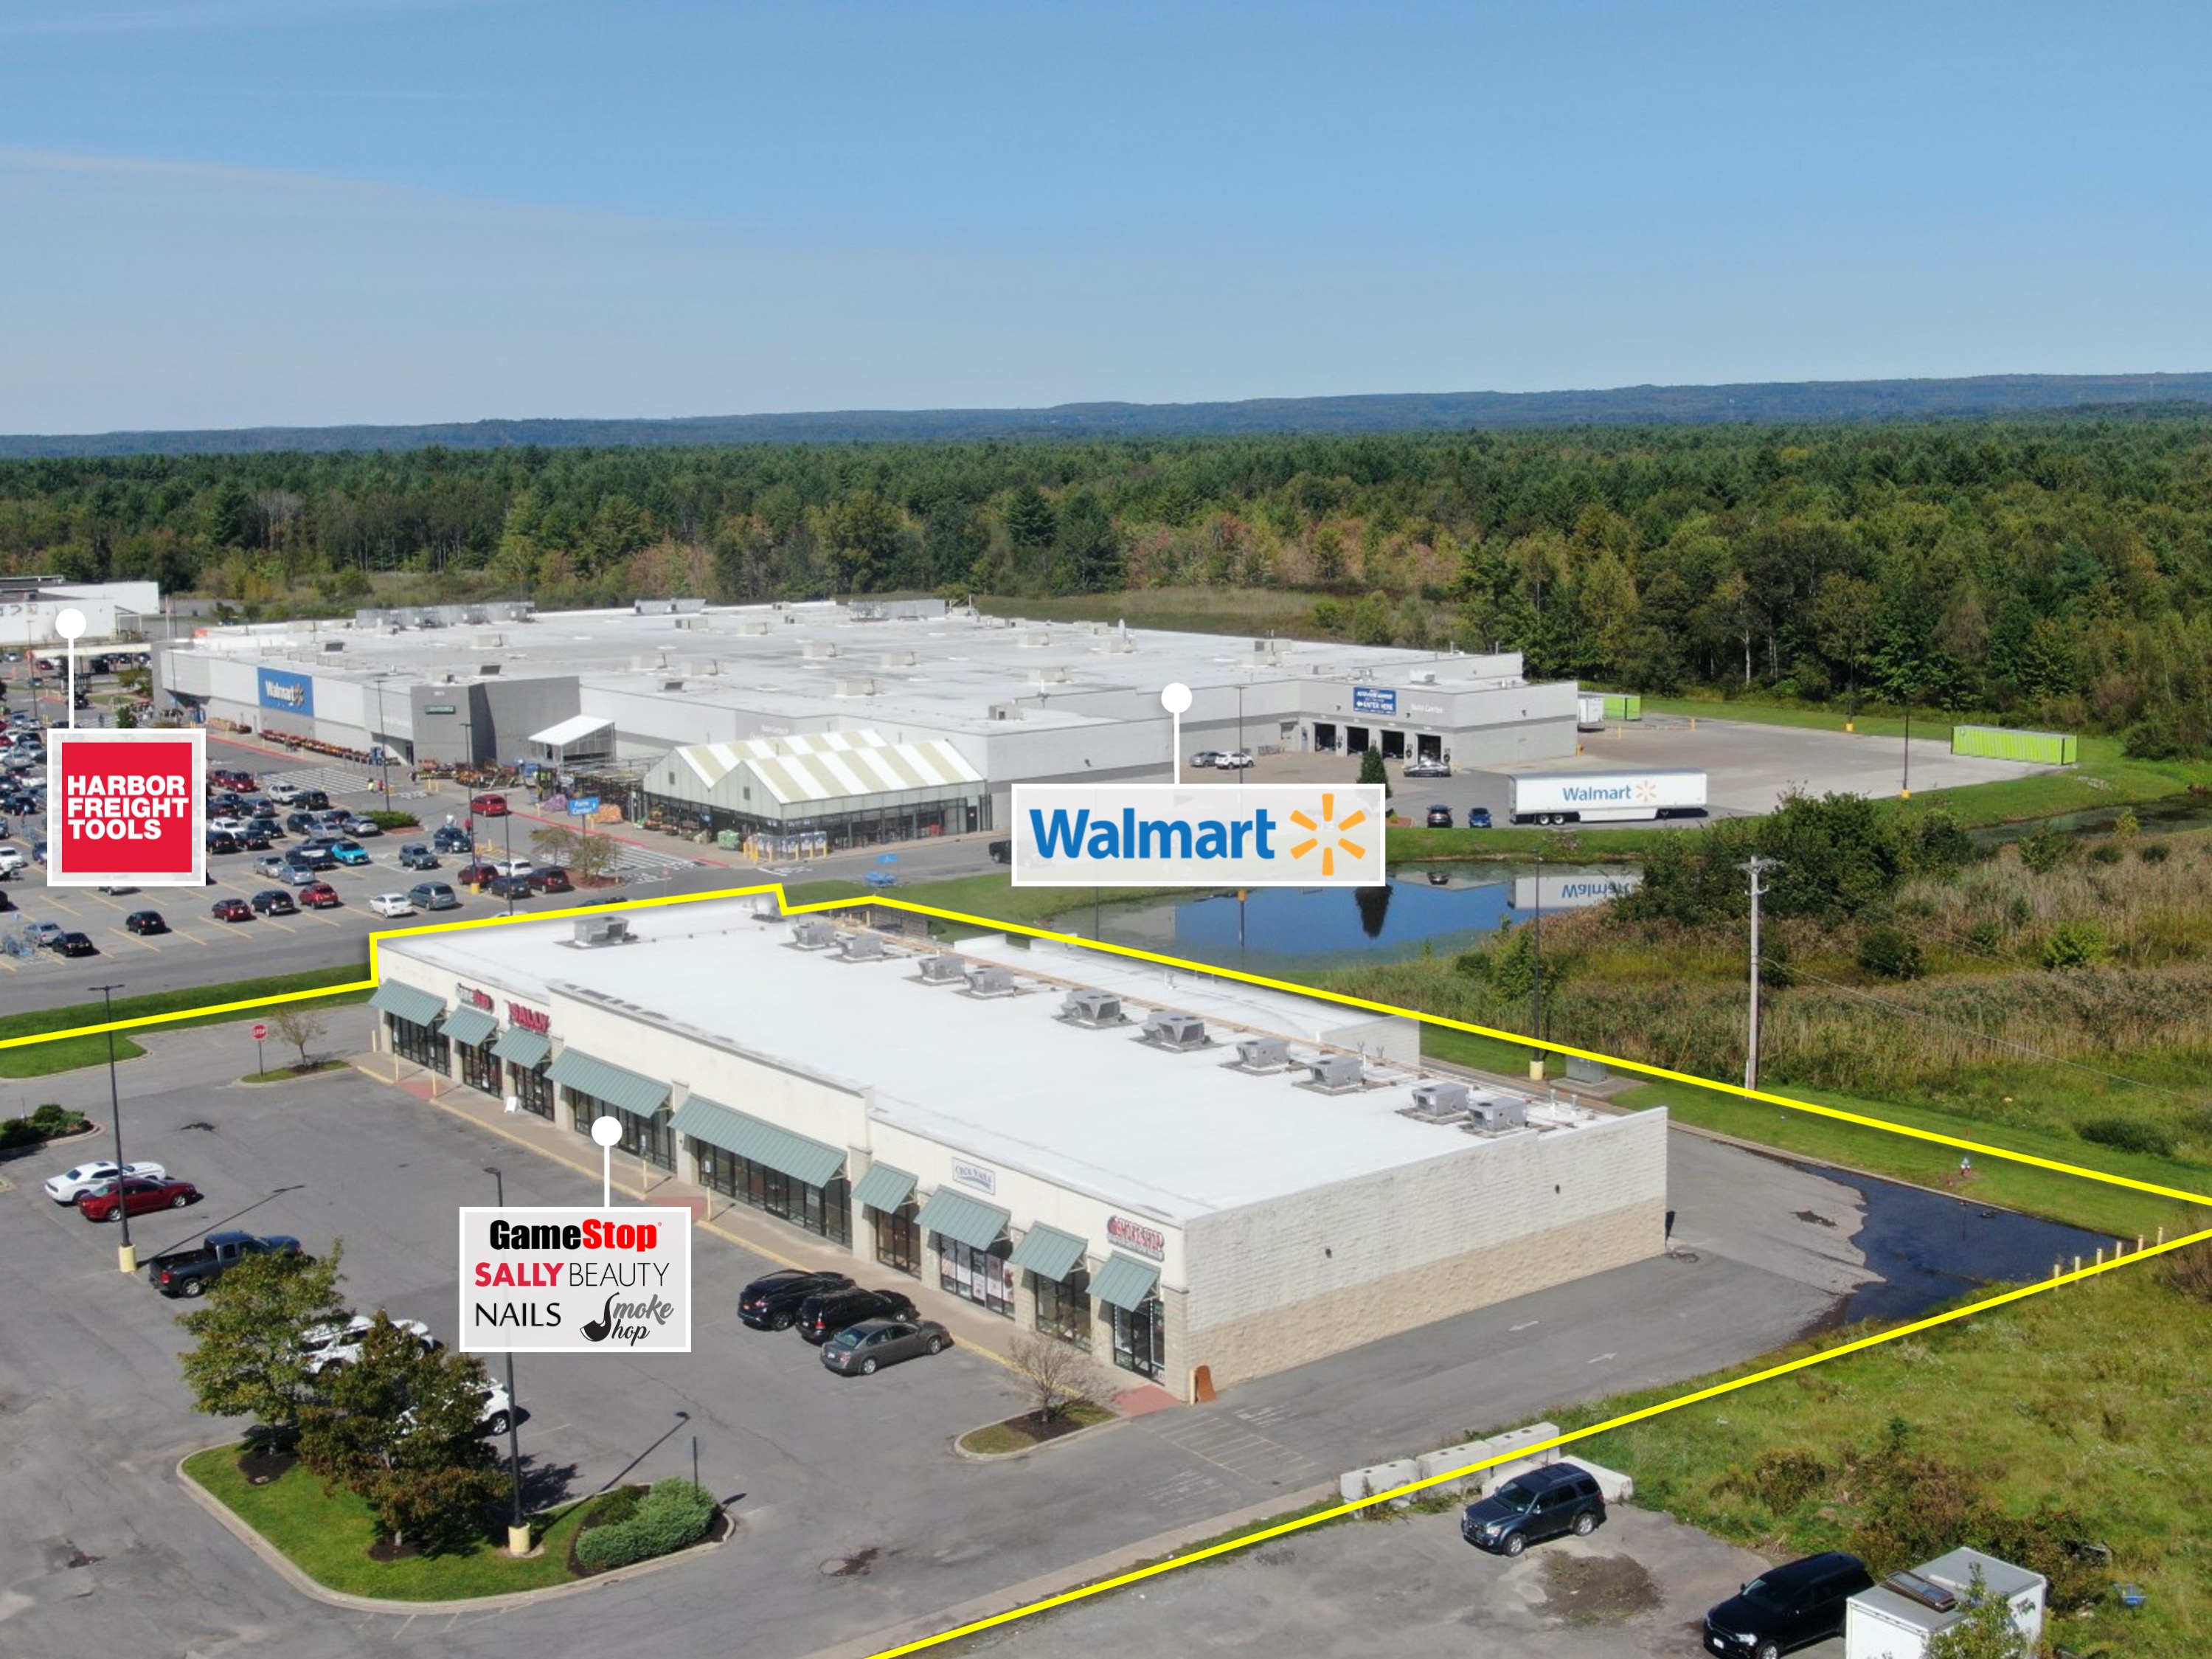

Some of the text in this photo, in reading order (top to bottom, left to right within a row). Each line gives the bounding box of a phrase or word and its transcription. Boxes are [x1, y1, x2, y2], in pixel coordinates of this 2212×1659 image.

[266, 680, 295, 702] Walmart
[1563, 785, 1632, 801] Walmart
[509, 1002, 549, 1033] SALLY
